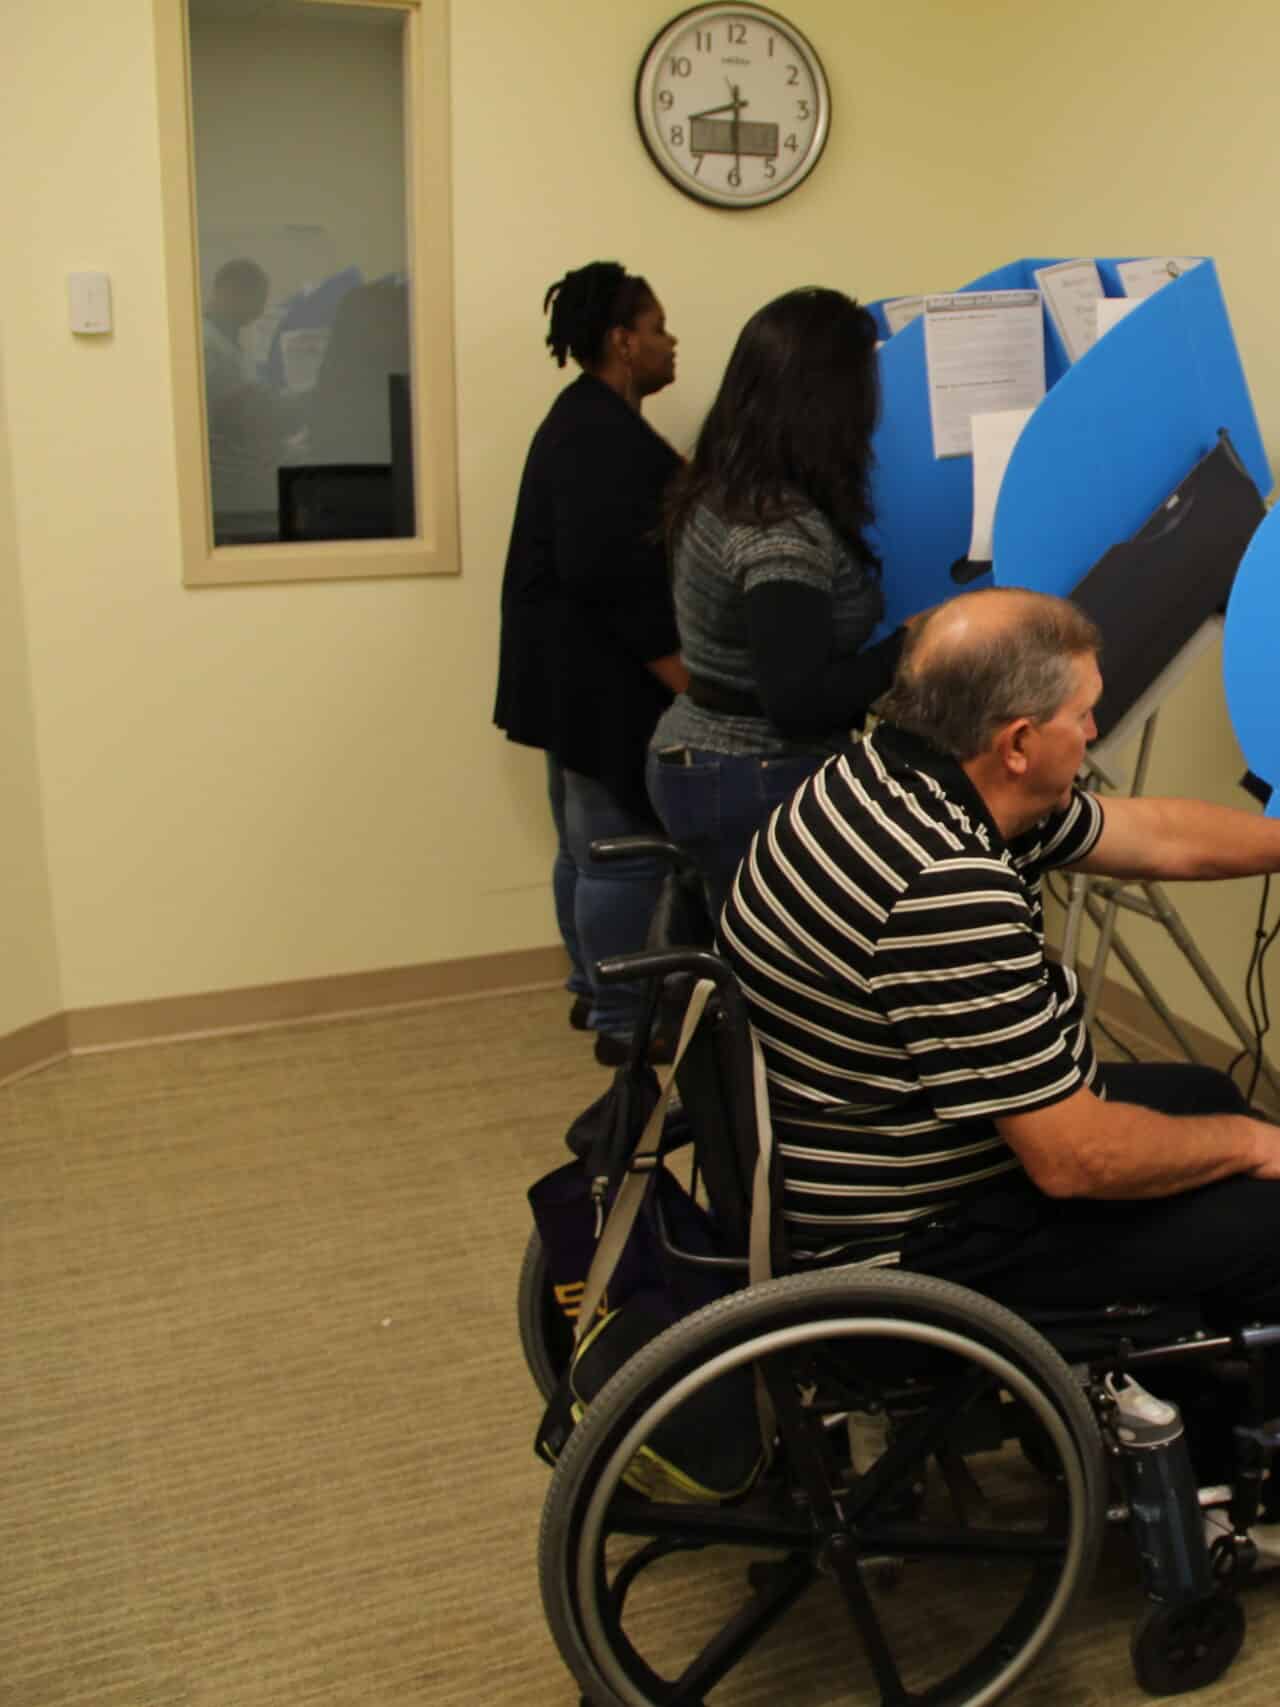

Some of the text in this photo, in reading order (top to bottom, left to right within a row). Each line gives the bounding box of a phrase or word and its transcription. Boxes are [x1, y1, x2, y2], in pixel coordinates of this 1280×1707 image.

[696, 31, 712, 53] 11
[727, 23, 748, 45] 12
[767, 36, 775, 57] 1
[670, 56, 692, 78] 10
[785, 65, 800, 86] 2
[659, 90, 674, 111] 9
[796, 99, 810, 121] 3
[670, 125, 684, 147] 8
[783, 133, 799, 152] 4
[690, 153, 705, 176] 7
[763, 156, 777, 179] 5
[727, 166, 742, 188] 6
